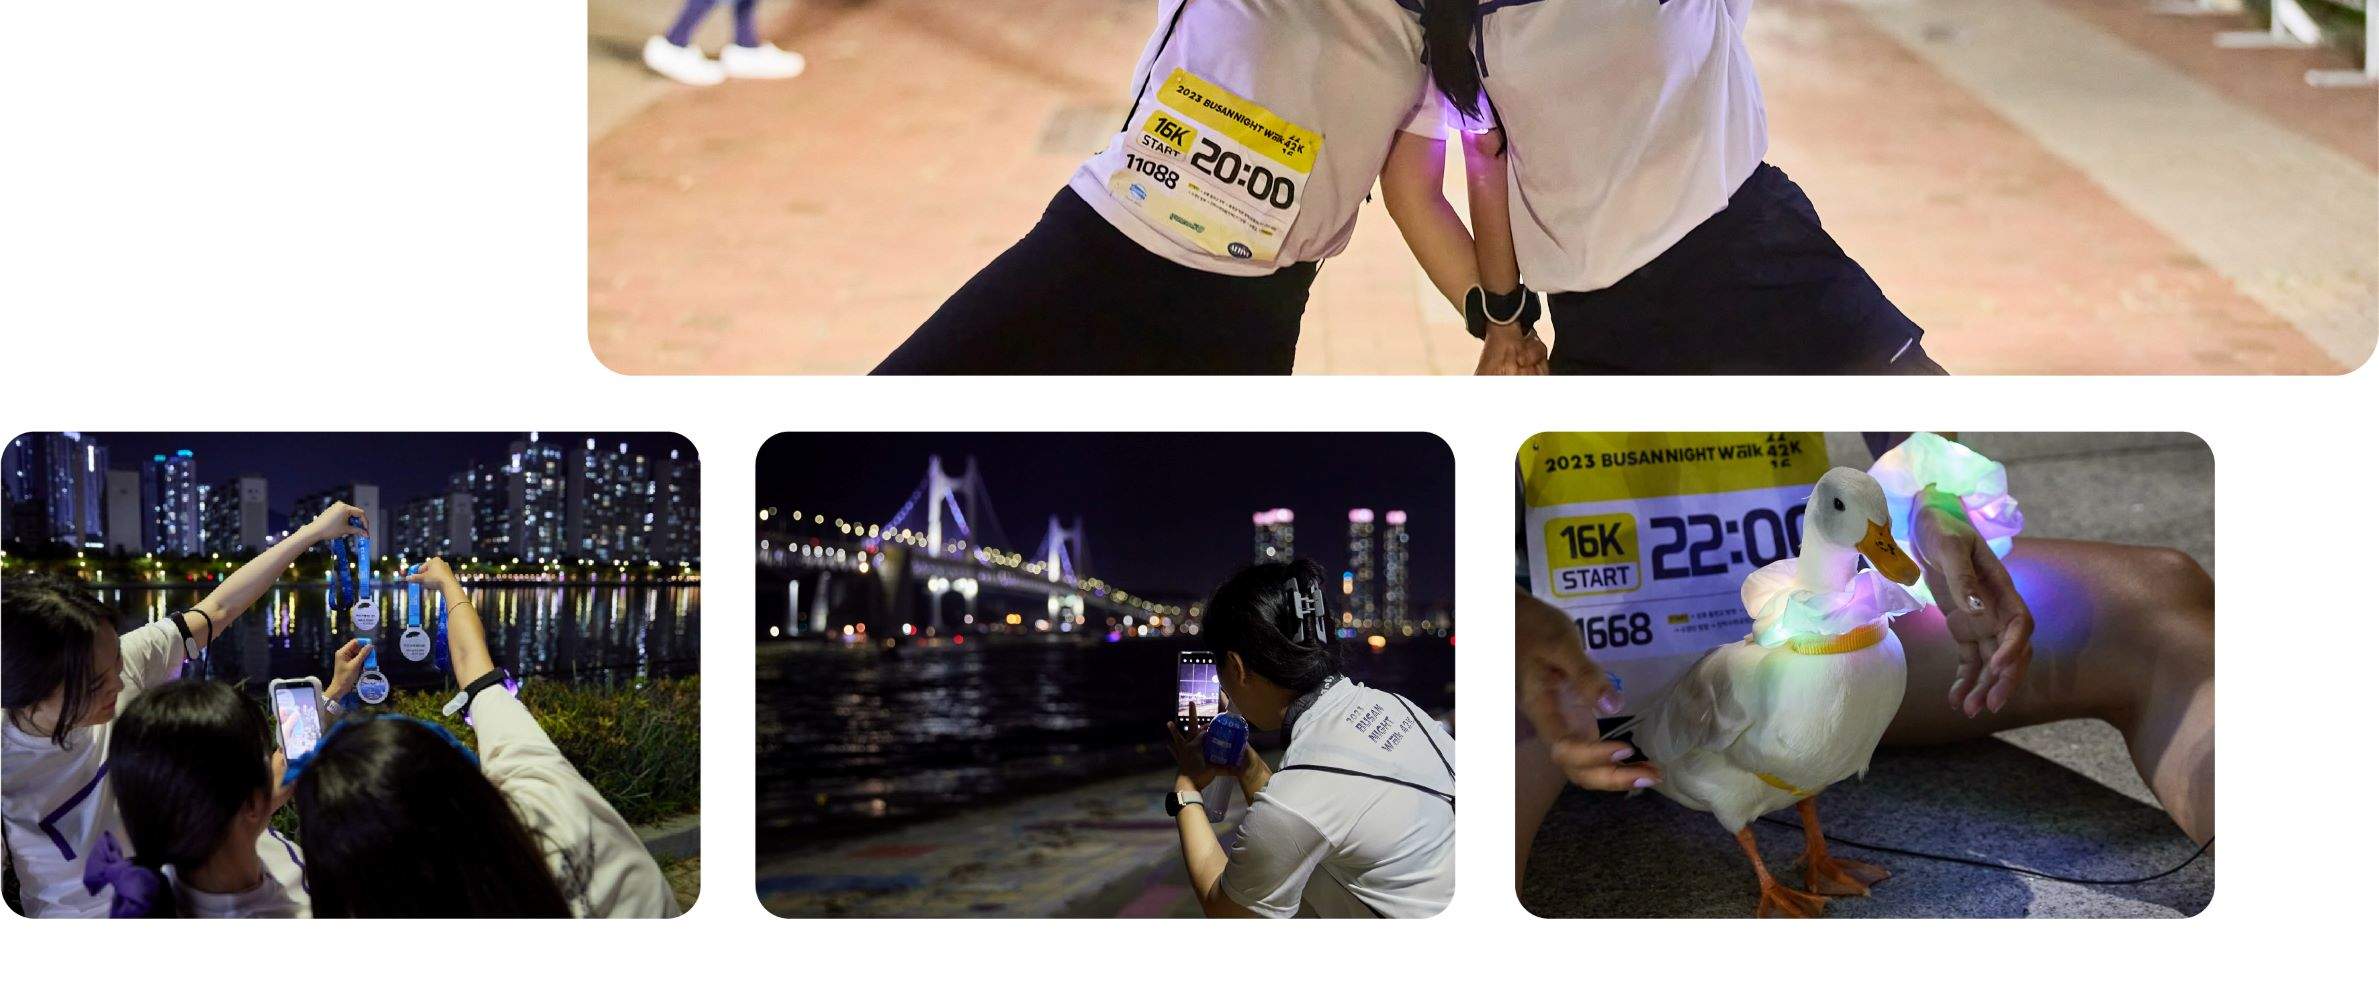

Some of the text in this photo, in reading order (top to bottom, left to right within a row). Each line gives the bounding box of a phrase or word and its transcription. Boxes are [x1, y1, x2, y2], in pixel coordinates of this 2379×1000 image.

[1151, 116, 1191, 147] 16K
[1177, 85, 1202, 103] 2023
[1284, 140, 1304, 154] 42K
[1141, 134, 1181, 158] START
[1126, 153, 1180, 190] 11088
[1190, 136, 1295, 210] 20:00
[1545, 453, 1596, 472] 2023
[1767, 440, 1803, 456] 42K
[1560, 521, 1625, 560] 16K
[1562, 565, 1630, 590] START
